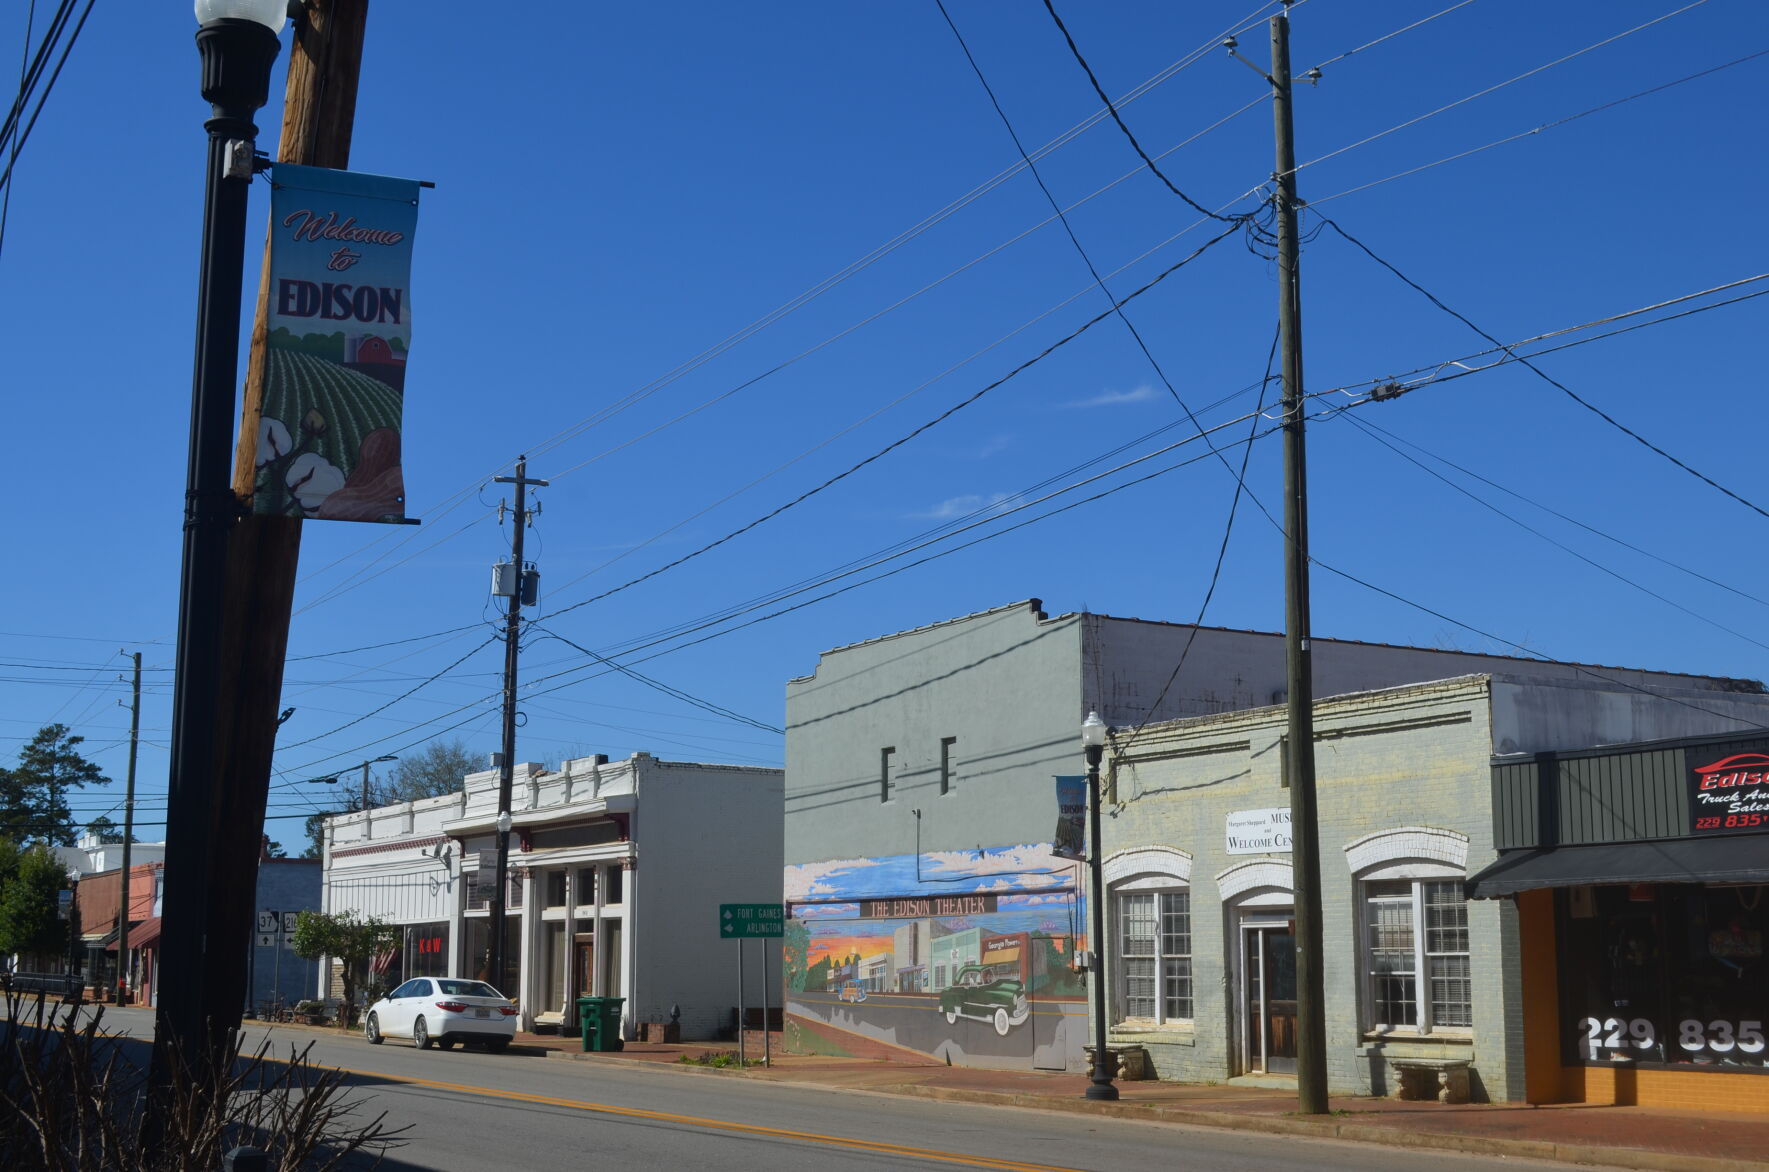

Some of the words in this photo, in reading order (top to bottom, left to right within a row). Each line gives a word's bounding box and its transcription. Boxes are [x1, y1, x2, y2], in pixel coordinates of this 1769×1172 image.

[283, 209, 403, 245] Welcome
[327, 247, 360, 271] to
[277, 279, 402, 325] EDISON
[1697, 791, 1739, 804] Truck
[1060, 804, 1084, 814] EDISON
[1728, 802, 1769, 813] Sales
[1271, 813, 1292, 824] MUS
[1696, 816, 1721, 829] 229
[1725, 814, 1761, 828] 835
[737, 908, 753, 919] FORT
[758, 908, 781, 919] GAINES
[870, 901, 889, 917] THE
[894, 899, 930, 916] EDISON
[935, 896, 985, 915] THEATER
[260, 916, 272, 928] 37
[746, 923, 782, 933] ARLINGTON
[419, 938, 425, 953] K
[433, 937, 442, 953] W
[1577, 1016, 1655, 1049] 229
[1678, 1019, 1765, 1053] 835
